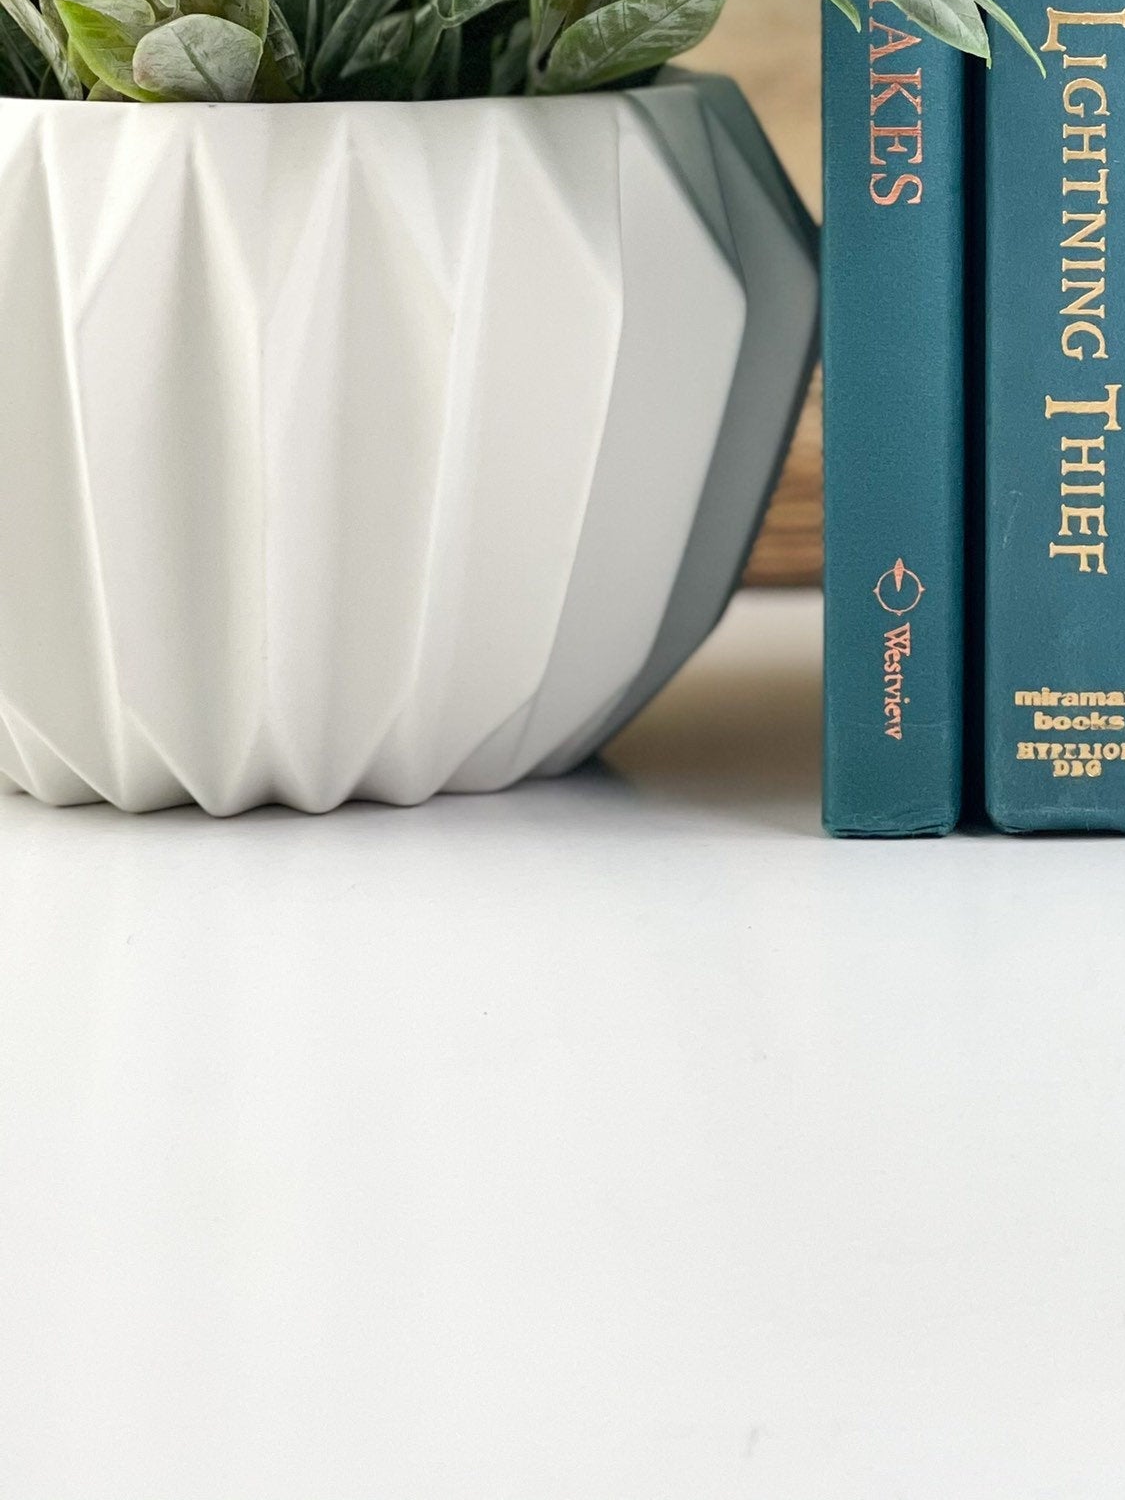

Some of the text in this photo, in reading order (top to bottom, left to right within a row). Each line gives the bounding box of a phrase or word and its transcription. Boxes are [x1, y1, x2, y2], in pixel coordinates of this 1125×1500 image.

[1045, 384, 1122, 574] THIEF
[884, 623, 910, 739] Westview
[1035, 712, 1125, 730] books
